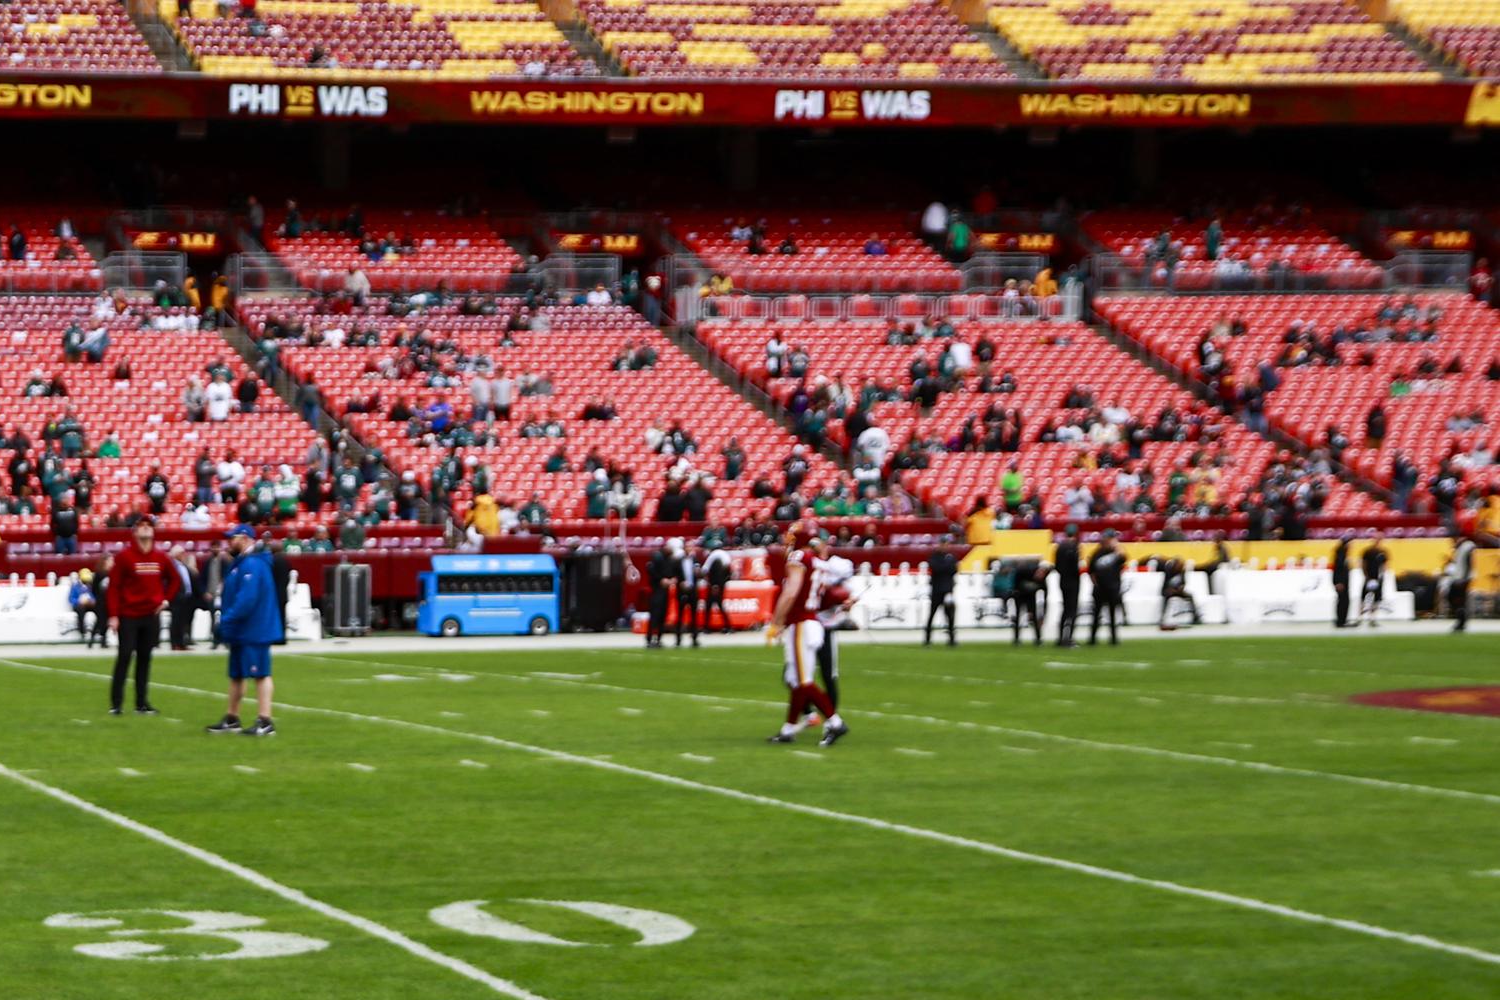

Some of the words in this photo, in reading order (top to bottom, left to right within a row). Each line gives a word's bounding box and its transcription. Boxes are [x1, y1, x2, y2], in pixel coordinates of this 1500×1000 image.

[229, 83, 279, 113] PHI
[318, 85, 388, 116] WAS
[470, 90, 704, 114] WASHINGTON
[774, 89, 825, 118] PHI
[861, 90, 932, 119] WAS
[1019, 93, 1251, 116] WASHINGTON
